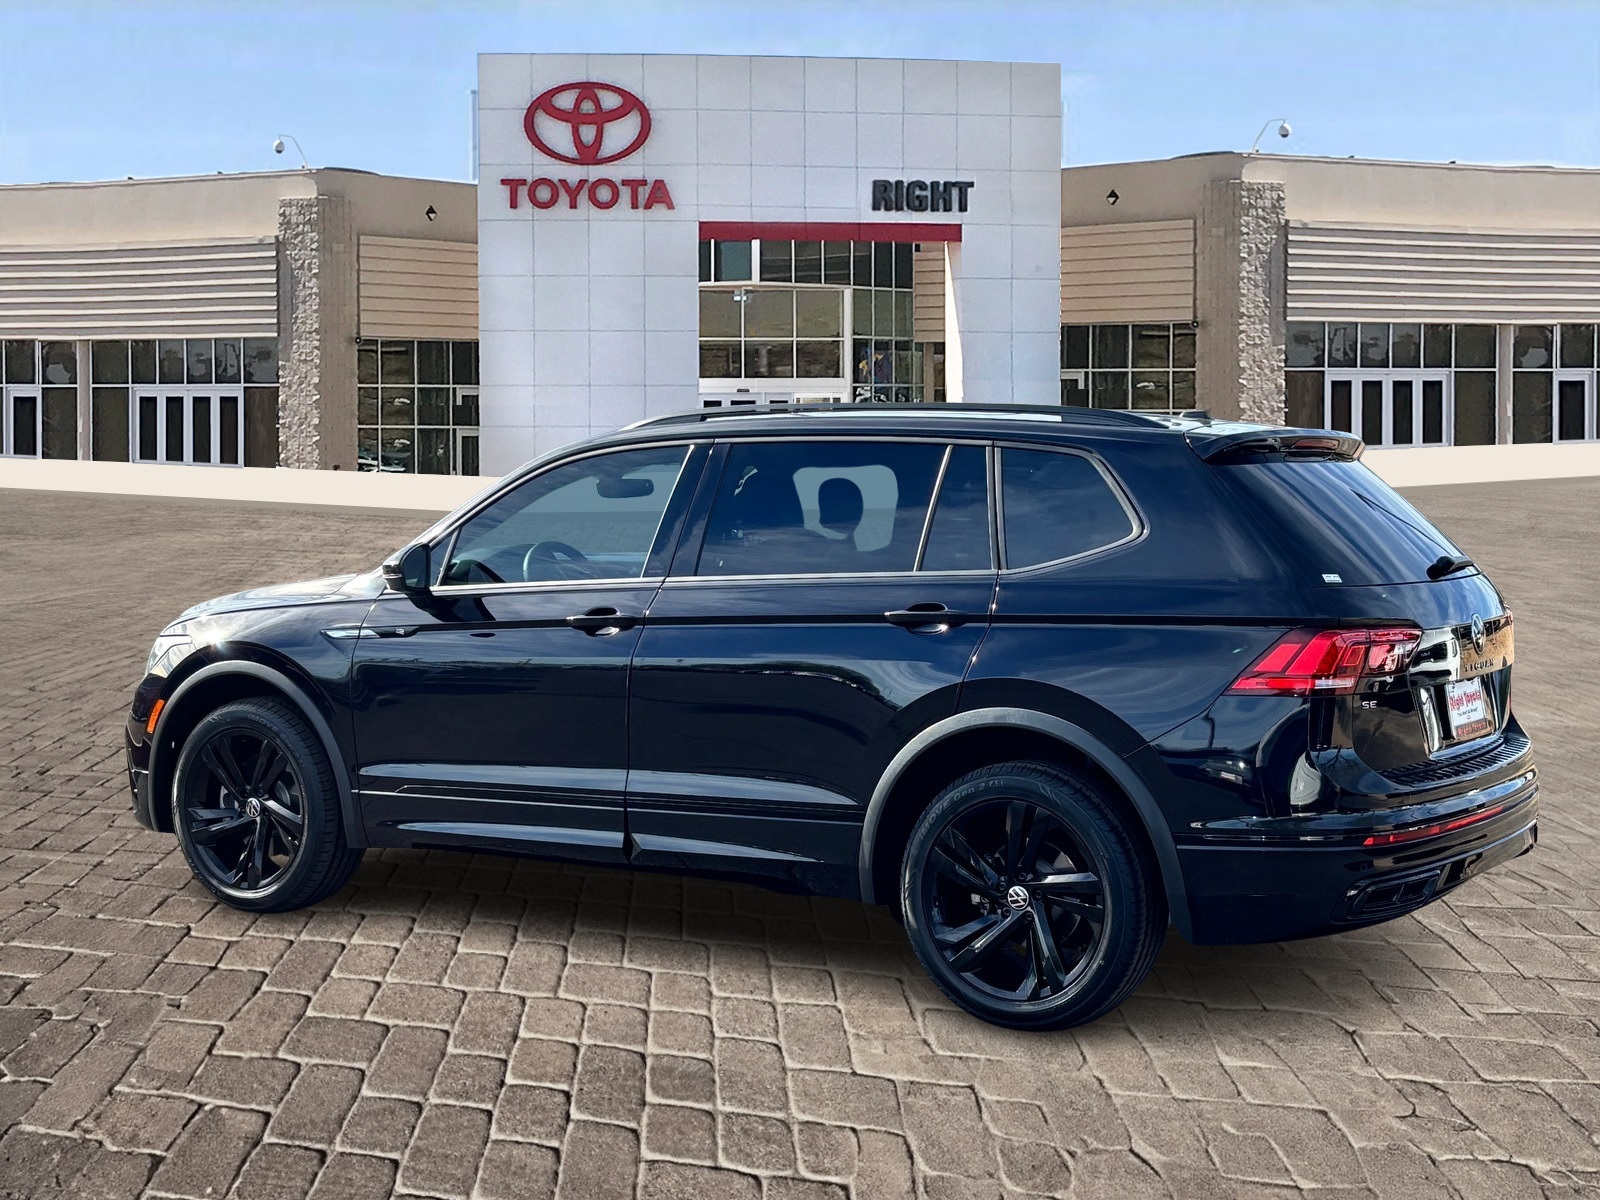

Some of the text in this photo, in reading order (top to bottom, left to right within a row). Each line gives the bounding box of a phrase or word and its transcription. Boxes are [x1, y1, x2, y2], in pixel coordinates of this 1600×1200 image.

[500, 178, 675, 211] TOYOTA
[871, 179, 975, 213] RIGHT
[1361, 700, 1378, 709] SE
[1449, 689, 1481, 712] Right Toyota
[953, 787, 975, 802] Gen
[978, 782, 986, 791] 2
